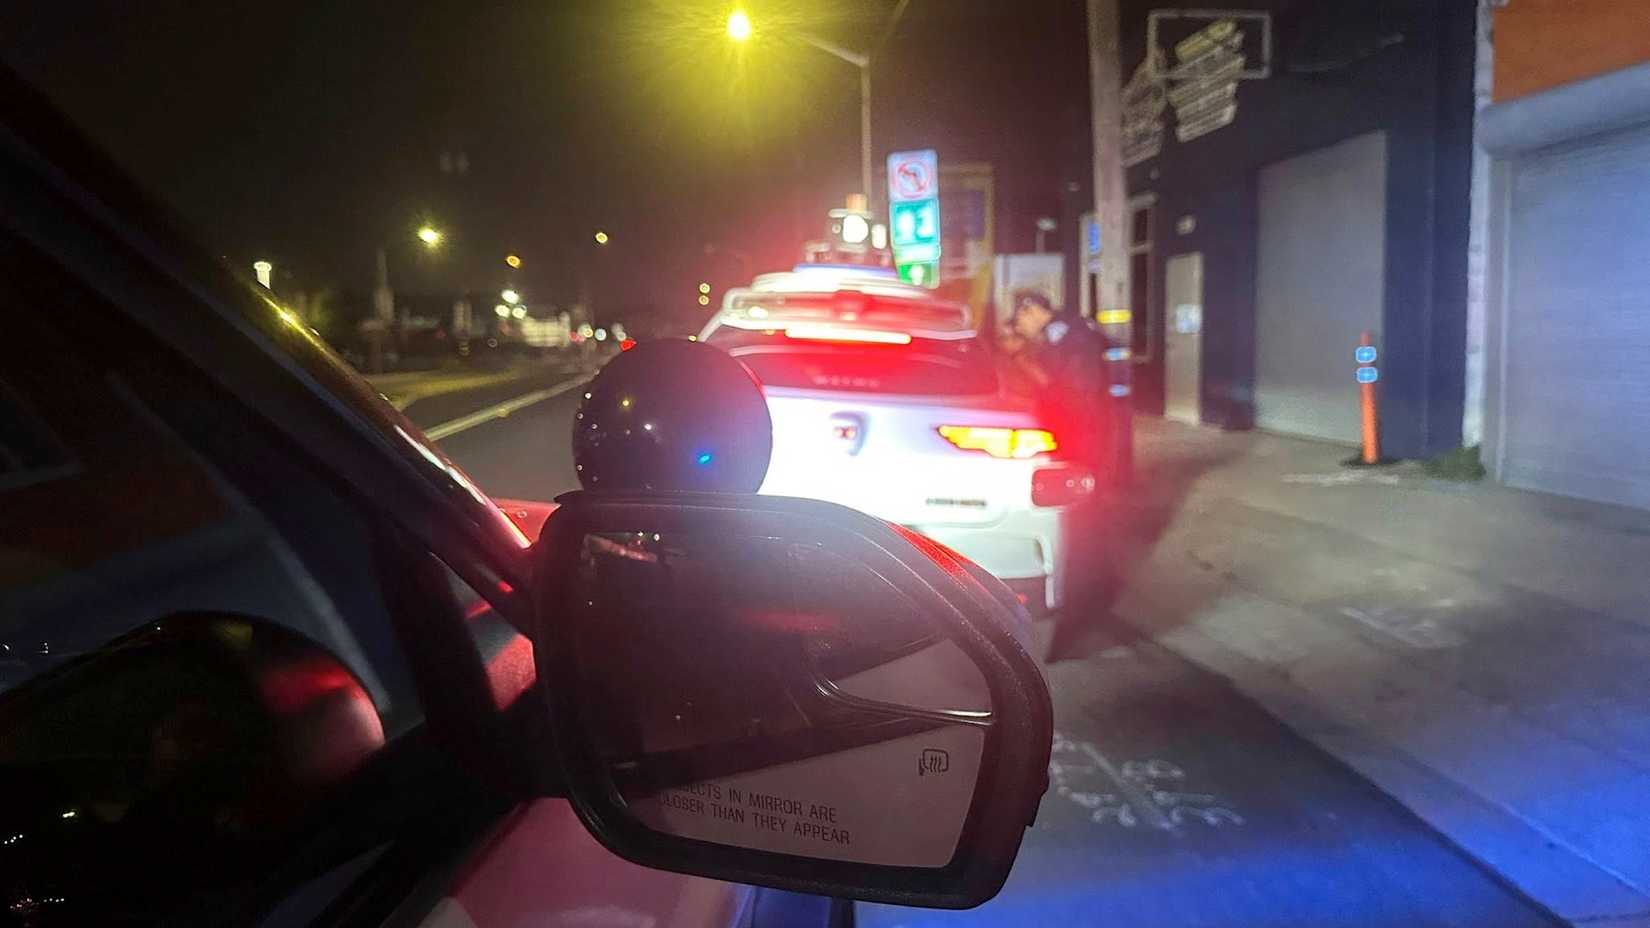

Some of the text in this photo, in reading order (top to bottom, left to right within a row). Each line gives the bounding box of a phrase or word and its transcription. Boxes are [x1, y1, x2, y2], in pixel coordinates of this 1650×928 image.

[711, 803, 745, 824] THAN
[752, 812, 786, 832] THEY
[793, 822, 850, 845] APPEAR
[728, 787, 742, 804] IN
[749, 793, 803, 816] MIRROR
[809, 804, 837, 823] ARE
